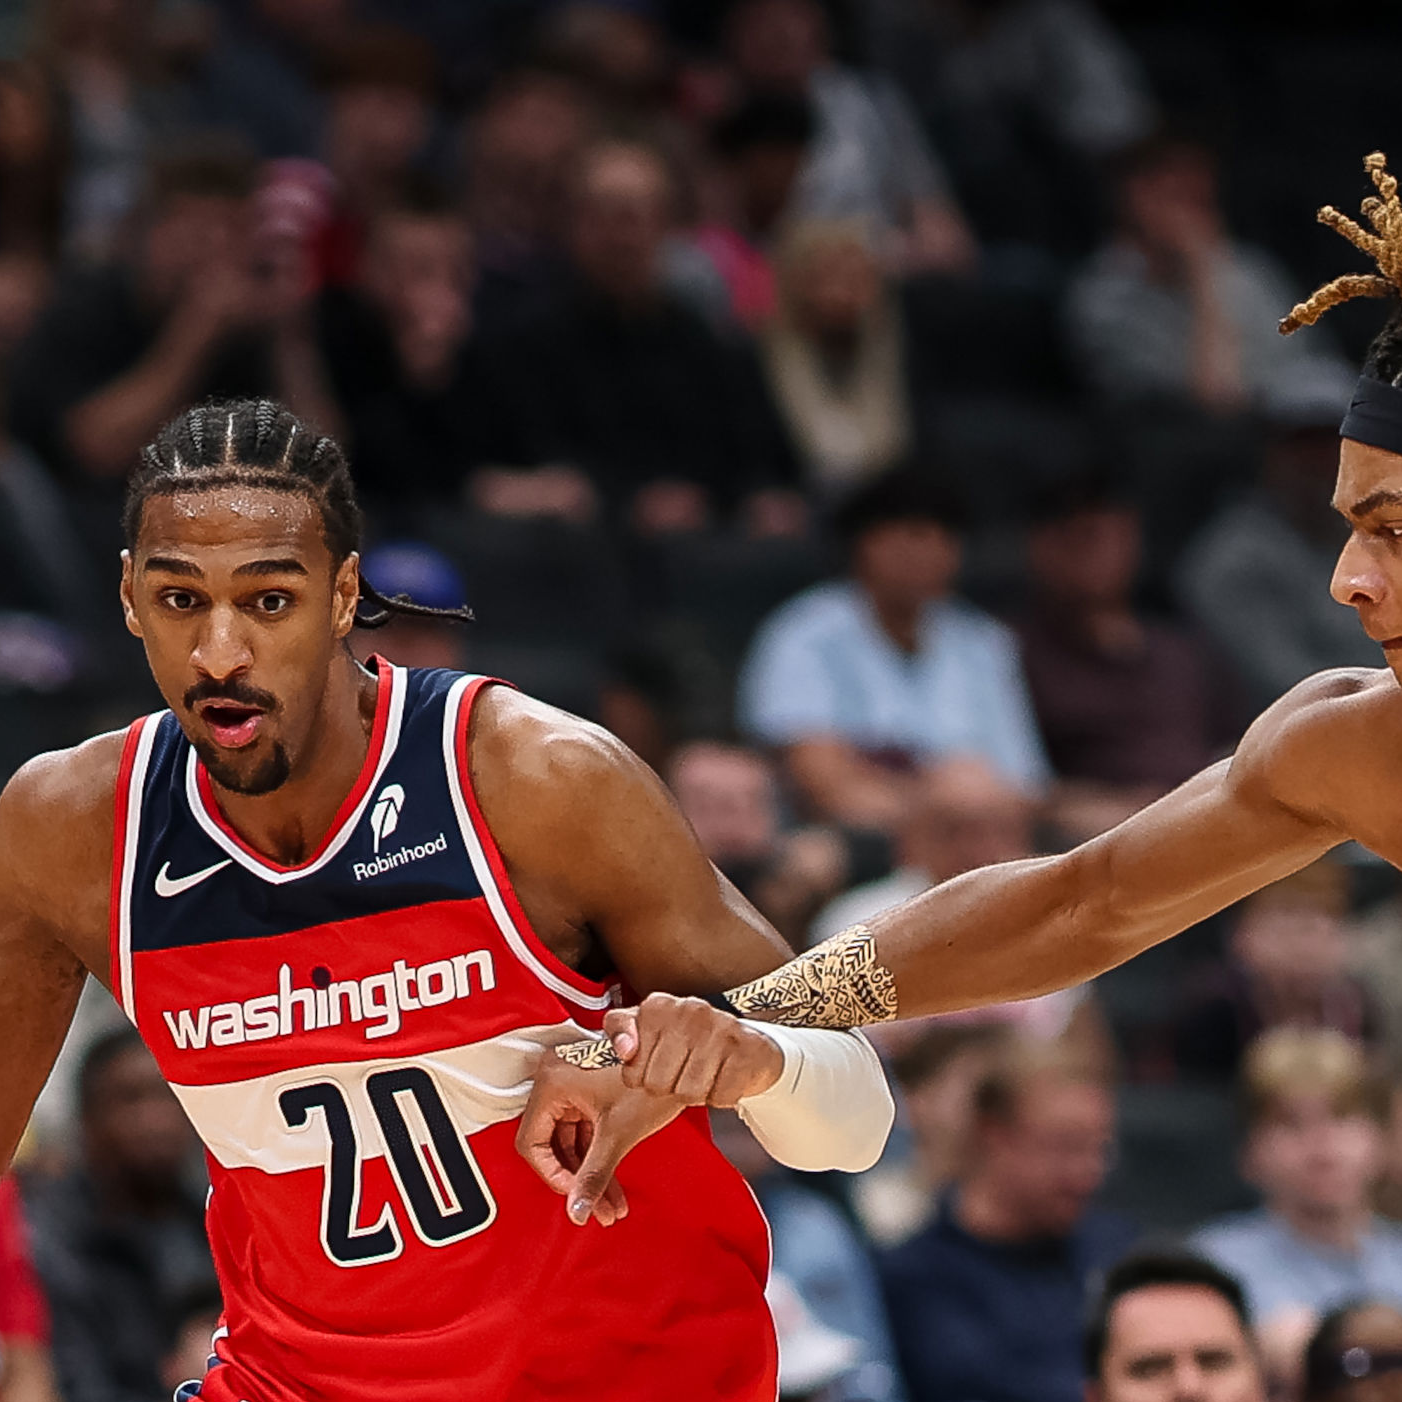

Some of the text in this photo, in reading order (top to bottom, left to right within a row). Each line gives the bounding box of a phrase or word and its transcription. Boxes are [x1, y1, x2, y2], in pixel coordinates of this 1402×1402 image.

[353, 832, 447, 881] Robinhood
[163, 949, 496, 1050] washington
[274, 1063, 497, 1268] 20
